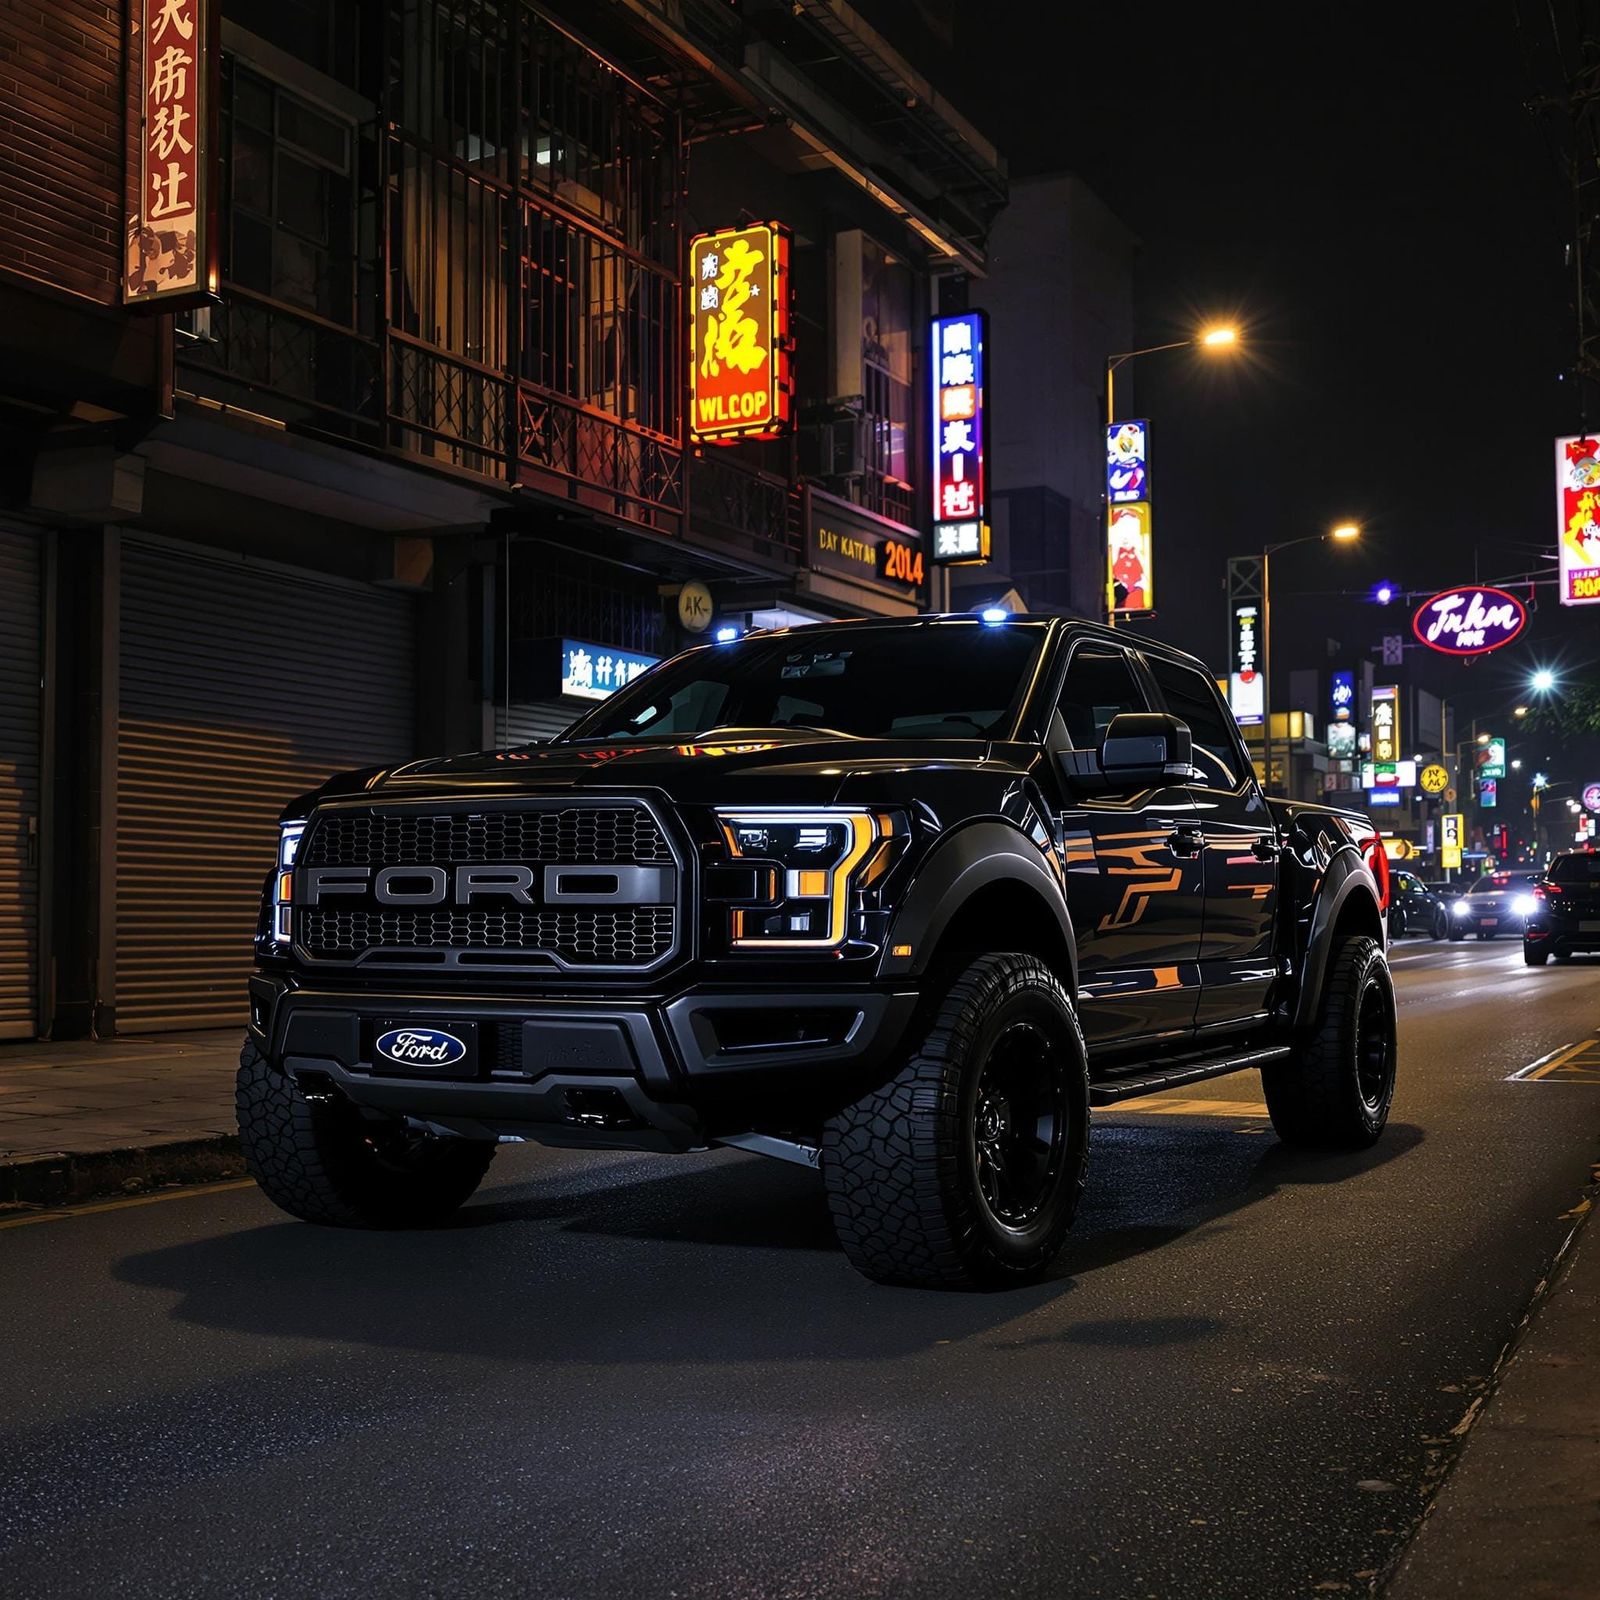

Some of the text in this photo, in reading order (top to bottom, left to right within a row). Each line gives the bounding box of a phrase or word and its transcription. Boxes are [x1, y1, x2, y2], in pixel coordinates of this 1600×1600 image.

[700, 390, 768, 422] WLCOP
[885, 540, 924, 585] 2014
[306, 865, 652, 904] FORD
[391, 1032, 449, 1061] Ford
